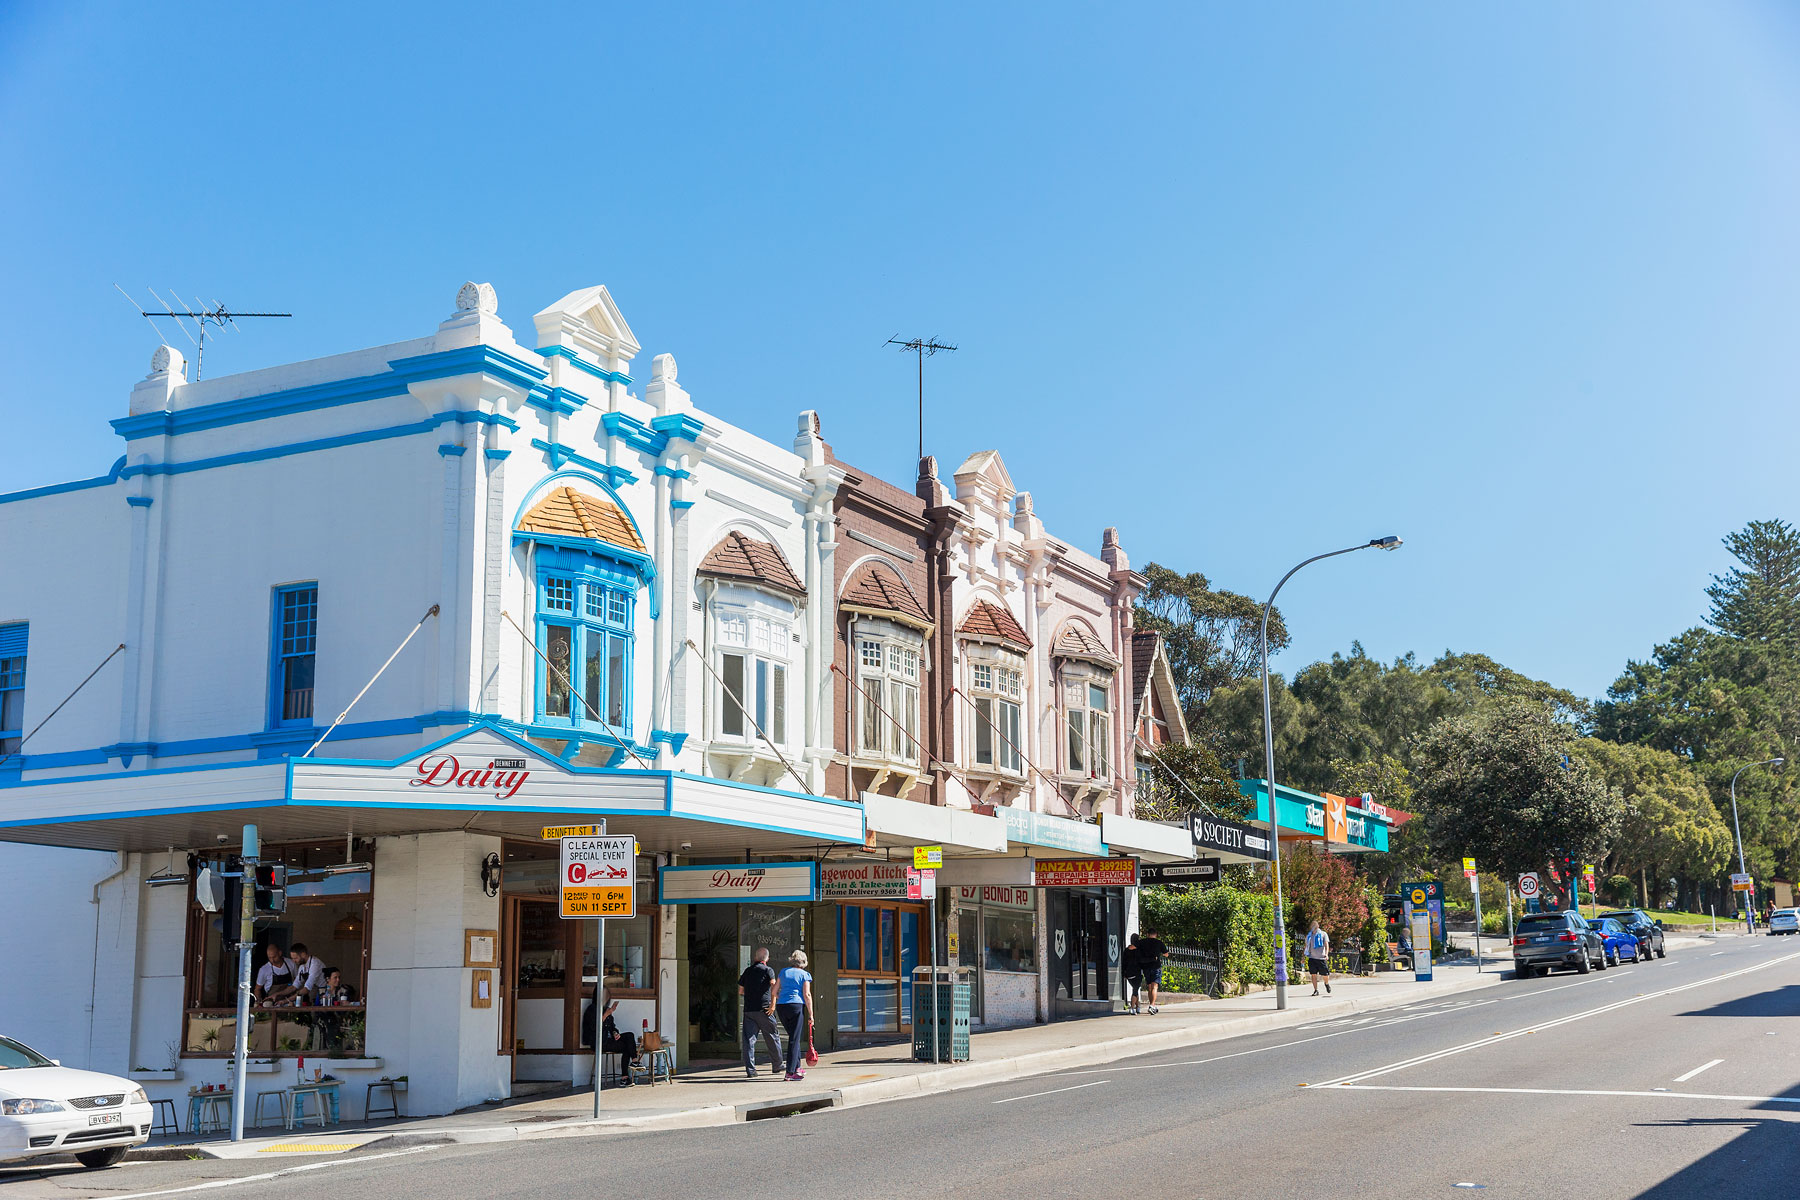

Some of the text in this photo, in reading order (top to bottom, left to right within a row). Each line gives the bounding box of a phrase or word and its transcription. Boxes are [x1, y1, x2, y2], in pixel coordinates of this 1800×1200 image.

[409, 754, 530, 800] Dairy
[547, 827, 587, 838] BENNETT ST
[1203, 821, 1243, 848] SOCIETY
[568, 841, 627, 850] CLEARWAY
[569, 851, 625, 861] SPECIAL EVENT
[1076, 861, 1095, 871] T.V.
[1099, 861, 1133, 871] 3892135
[571, 864, 583, 882] C
[821, 866, 868, 883] agewood
[873, 865, 907, 880] Kitche
[1140, 867, 1158, 878] ETY
[709, 869, 763, 892] Dairy
[1523, 881, 1535, 890] 50
[564, 893, 573, 901] 12
[607, 892, 624, 900] 6PM
[961, 886, 1028, 905] 67 BONDI RD
[570, 903, 627, 911] SUN 11 SEPT
